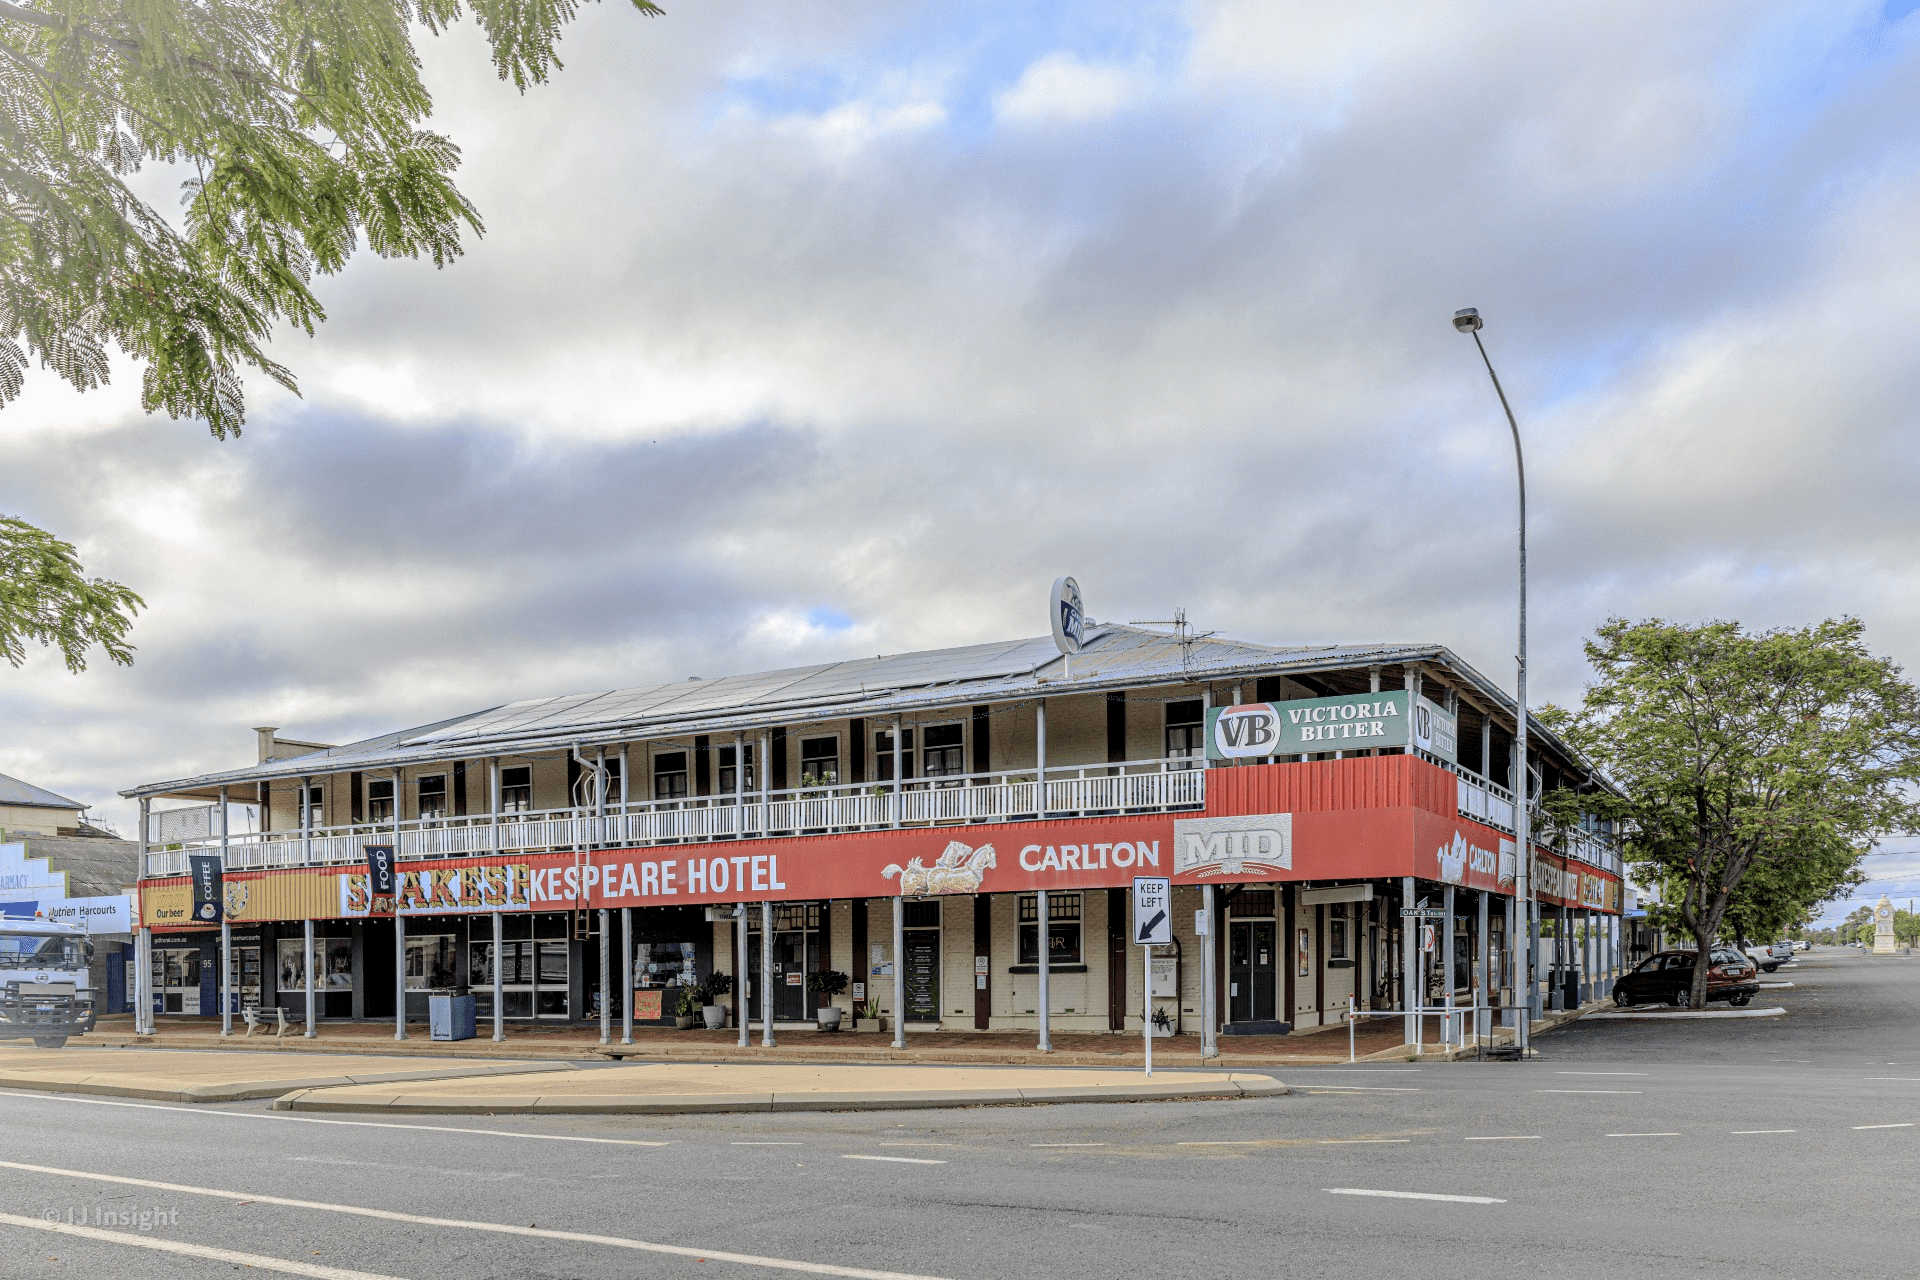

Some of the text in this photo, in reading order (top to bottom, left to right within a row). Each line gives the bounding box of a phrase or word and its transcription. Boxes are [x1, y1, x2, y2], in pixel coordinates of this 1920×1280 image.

[1288, 701, 1399, 724] VICTORIA
[1416, 705, 1430, 740] VB
[1217, 714, 1276, 748] VB
[1300, 720, 1386, 742] BITTER
[1019, 840, 1160, 872] CARLTON
[1182, 828, 1284, 865] MID
[1469, 844, 1497, 875] CARLTON
[202, 861, 212, 900] COFFEE
[376, 850, 389, 890] FOOD
[530, 854, 786, 901] KESPEARE HOTEL
[347, 864, 530, 912] SAKESP
[1140, 883, 1164, 894] KEEP
[1141, 897, 1163, 908] LEFT
[79, 905, 116, 916] Harcourts
[156, 908, 184, 918] Our beer
[203, 960, 212, 968] 95
